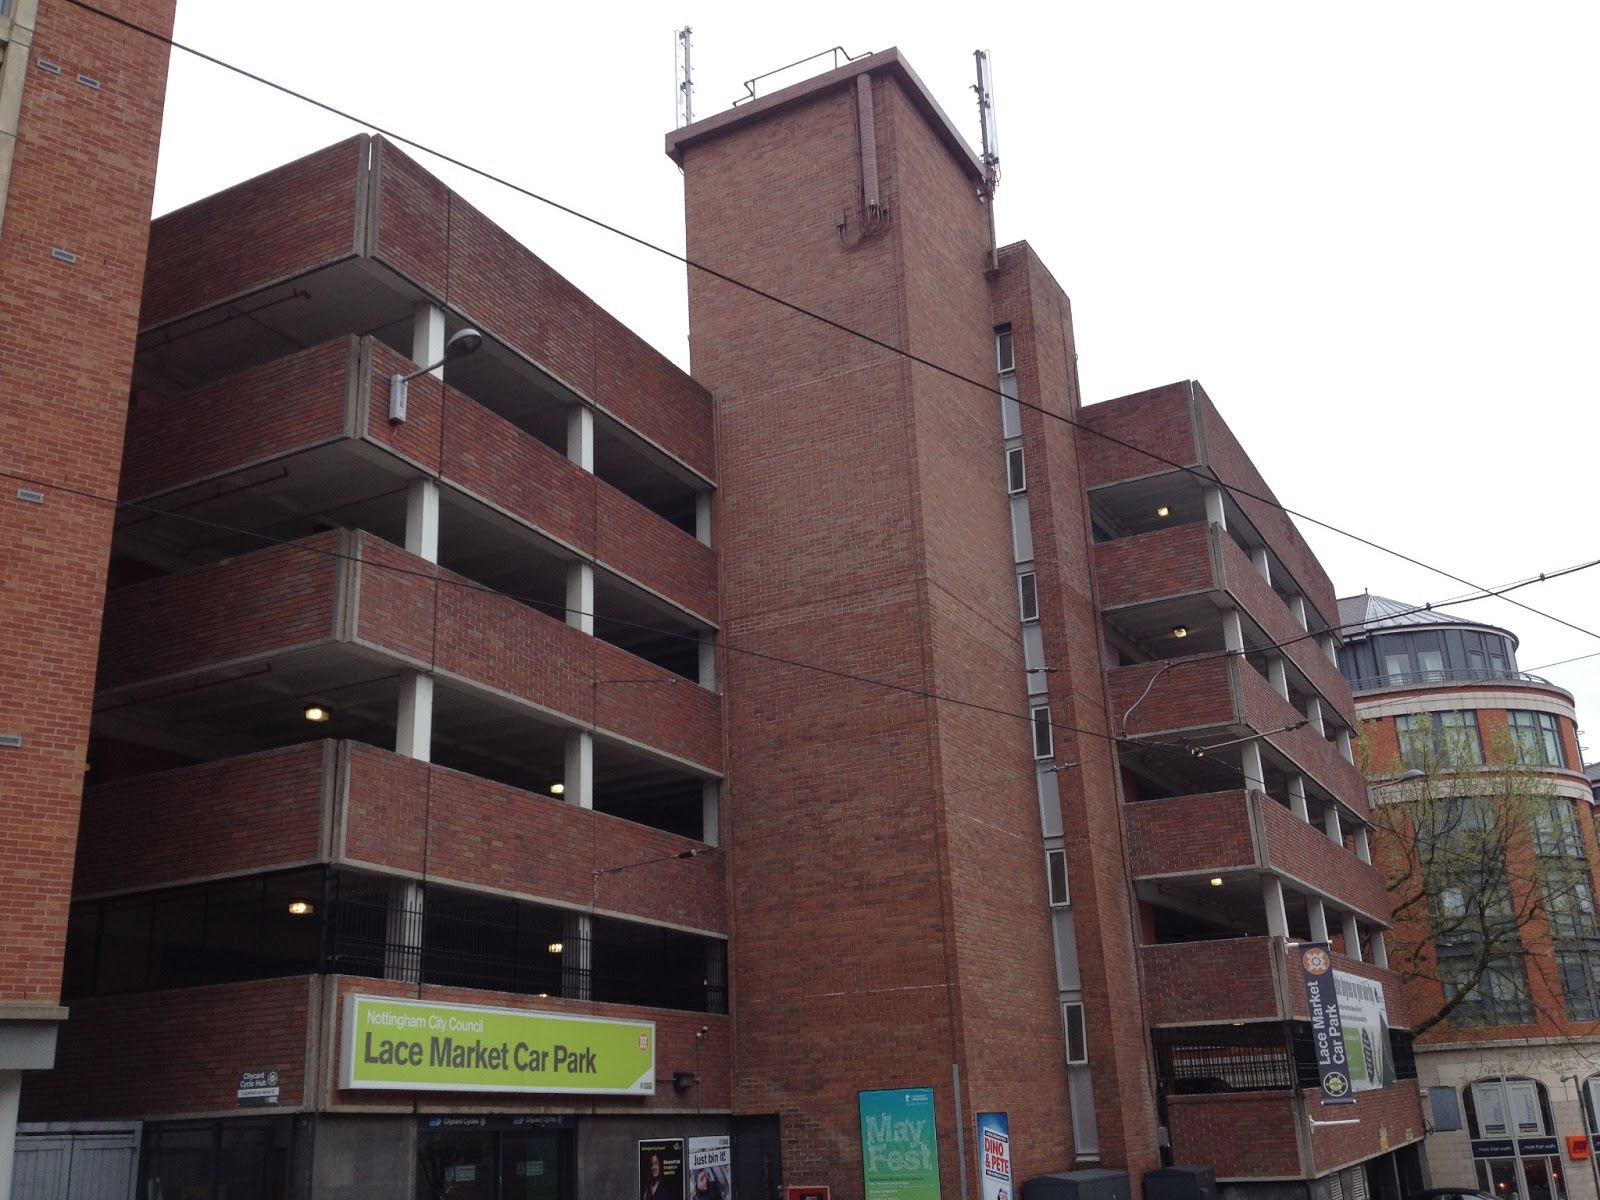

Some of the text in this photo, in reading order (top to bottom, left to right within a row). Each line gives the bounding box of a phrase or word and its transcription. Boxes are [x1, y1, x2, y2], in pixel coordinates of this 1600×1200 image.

[366, 1009, 484, 1033] Nottingham City Council
[1307, 981, 1331, 1065] Lace Market
[1325, 1004, 1345, 1065] Car Park
[364, 1031, 598, 1074] Lace Market Car Park
[240, 1079, 267, 1088] Cycle Hub
[243, 1072, 265, 1081] Citycard
[866, 1112, 927, 1148] May
[694, 1154, 707, 1166] Just
[708, 1152, 719, 1164] bin
[868, 1142, 932, 1172] Fest
[985, 1137, 1004, 1157] DINO
[985, 1153, 1009, 1174] & PETE
